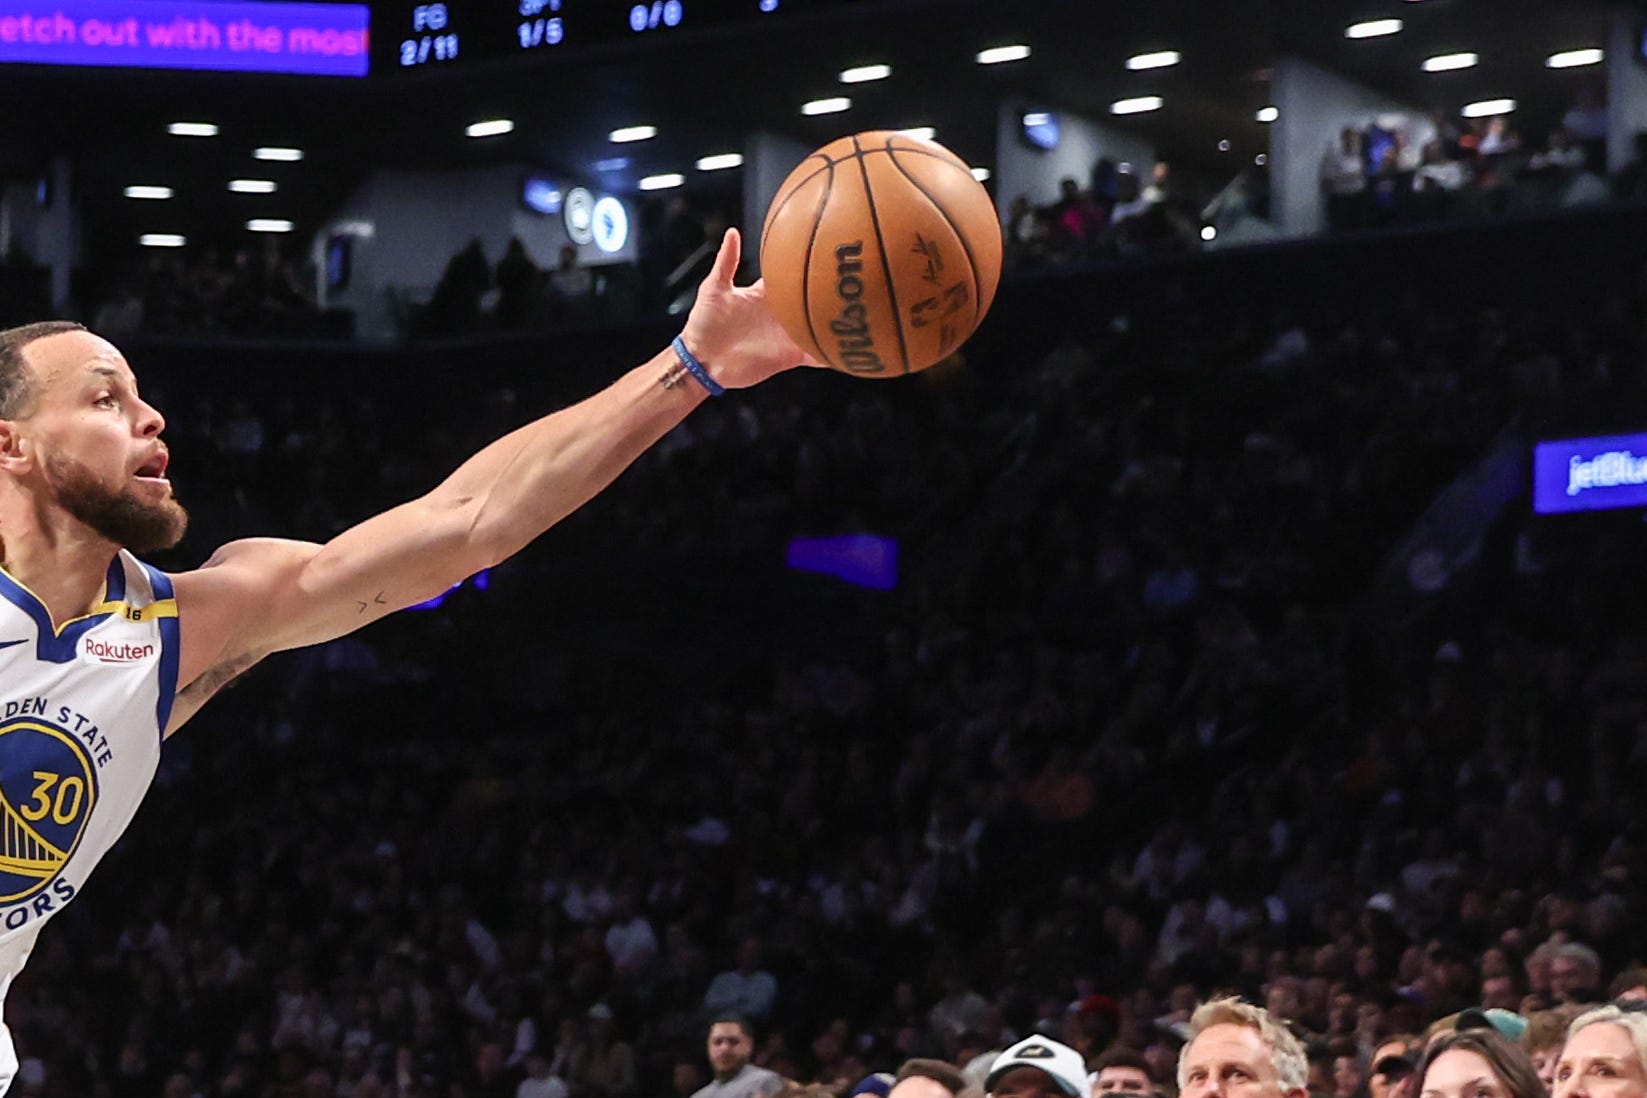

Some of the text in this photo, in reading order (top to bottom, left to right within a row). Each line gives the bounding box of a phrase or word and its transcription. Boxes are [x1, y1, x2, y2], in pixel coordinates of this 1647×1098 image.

[81, 18, 139, 46] out
[146, 16, 221, 50] with
[226, 20, 282, 53] the
[829, 239, 886, 373] Wilson
[125, 606, 142, 621] 16
[85, 638, 154, 660] Rakuten
[57, 706, 113, 768] STATE
[20, 771, 84, 825] 30
